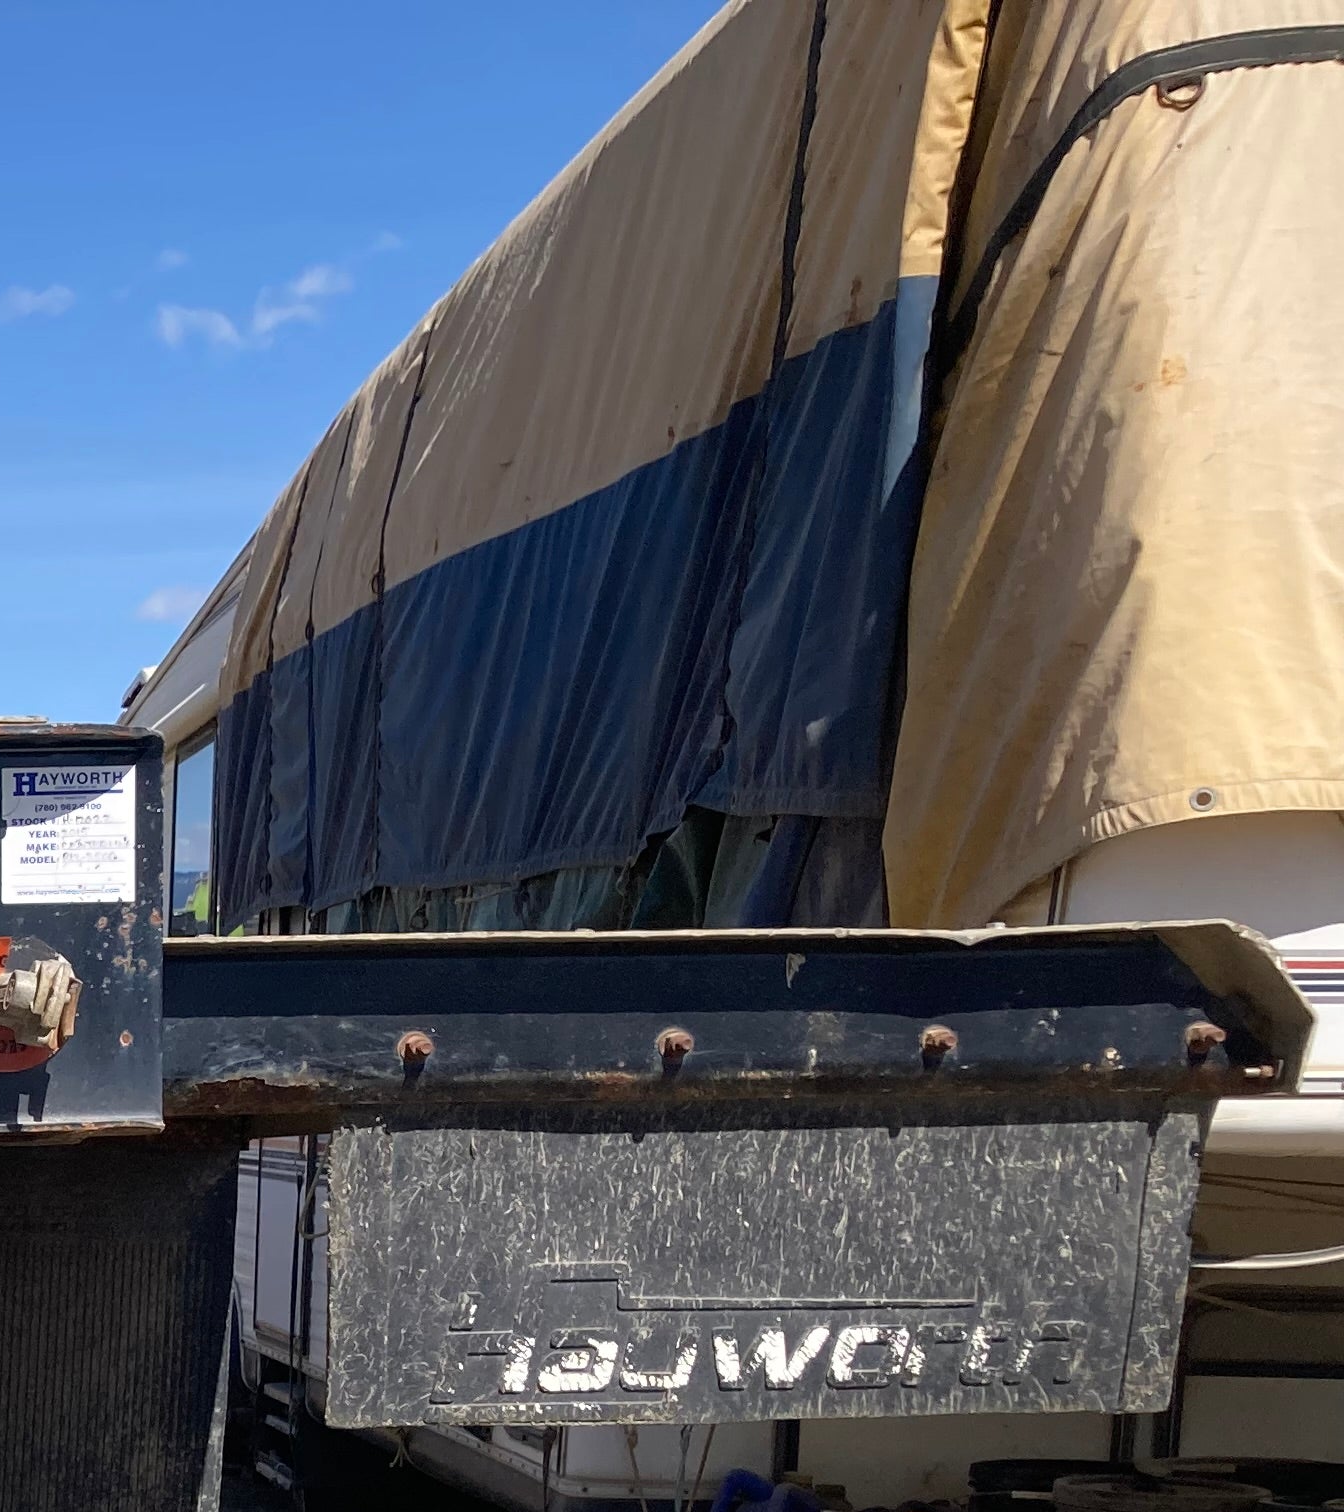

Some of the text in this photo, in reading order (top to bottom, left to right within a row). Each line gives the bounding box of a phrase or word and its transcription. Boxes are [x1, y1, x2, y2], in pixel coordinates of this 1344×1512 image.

[12, 771, 123, 797] HAYWORTH
[35, 803, 58, 813] (780)
[12, 817, 47, 826] STOCK
